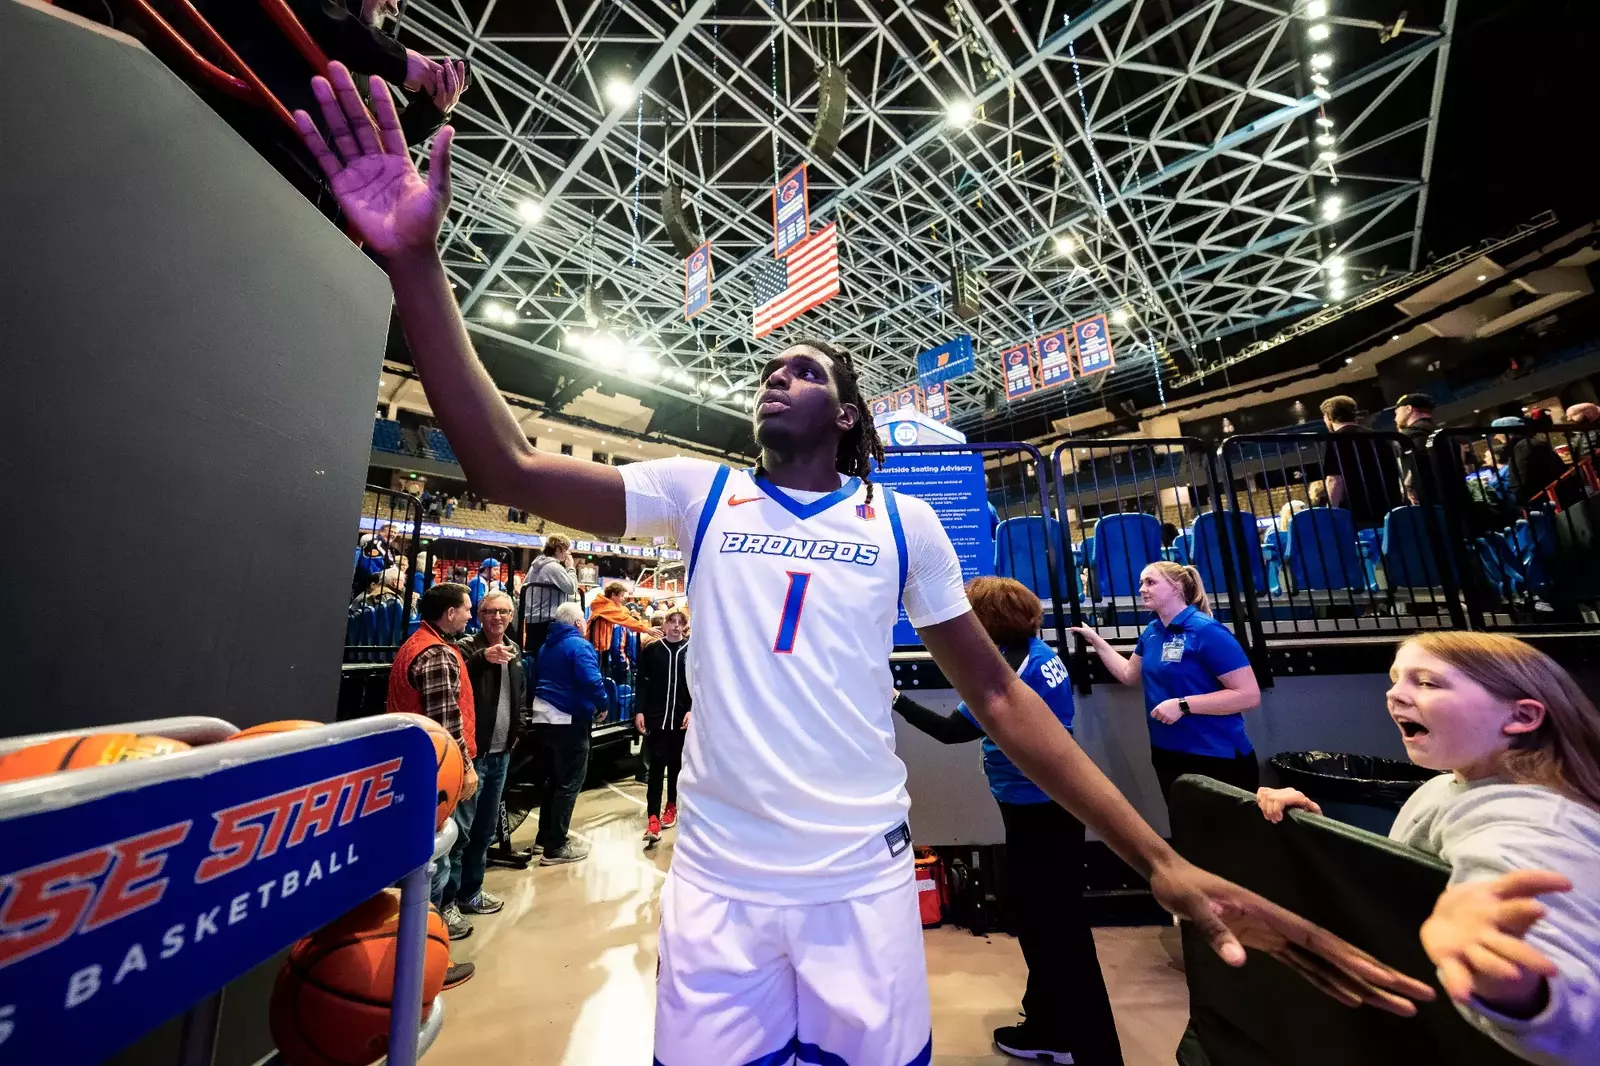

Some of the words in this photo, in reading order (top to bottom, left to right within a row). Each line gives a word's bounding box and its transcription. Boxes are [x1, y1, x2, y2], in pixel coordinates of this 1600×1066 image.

[911, 465, 939, 473] Seating
[940, 464, 973, 472] Advisory
[720, 532, 880, 566] BRONCOS
[774, 571, 811, 654] 1
[194, 757, 404, 884] STATE
[500, 800, 509, 842] ROGUE
[64, 843, 359, 1010] BASKETBALL
